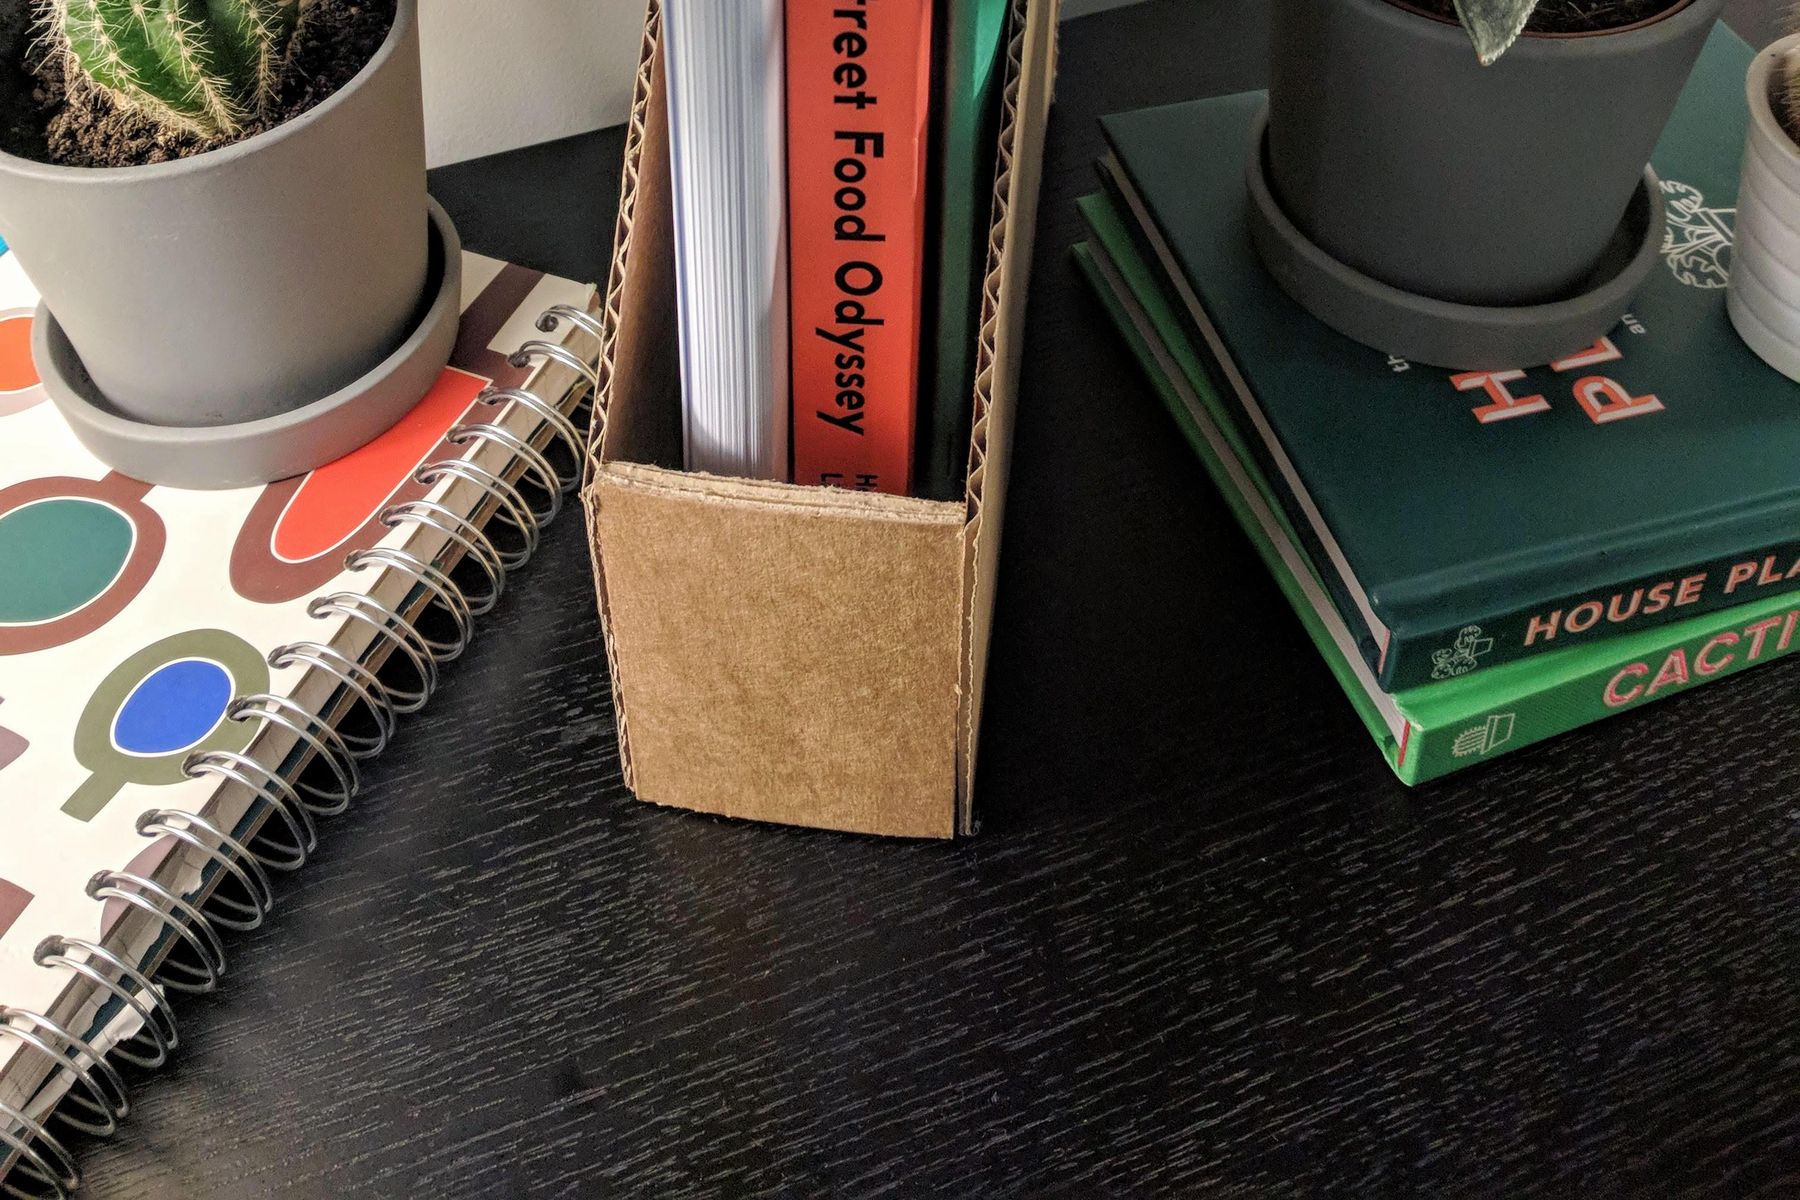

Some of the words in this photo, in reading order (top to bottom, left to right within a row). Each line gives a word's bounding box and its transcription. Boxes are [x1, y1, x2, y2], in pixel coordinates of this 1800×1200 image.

[833, 131, 886, 242] Food
[815, 261, 883, 436] Odyssey
[1523, 572, 1708, 647] HOUSE
[1603, 610, 1800, 708] CACTI
